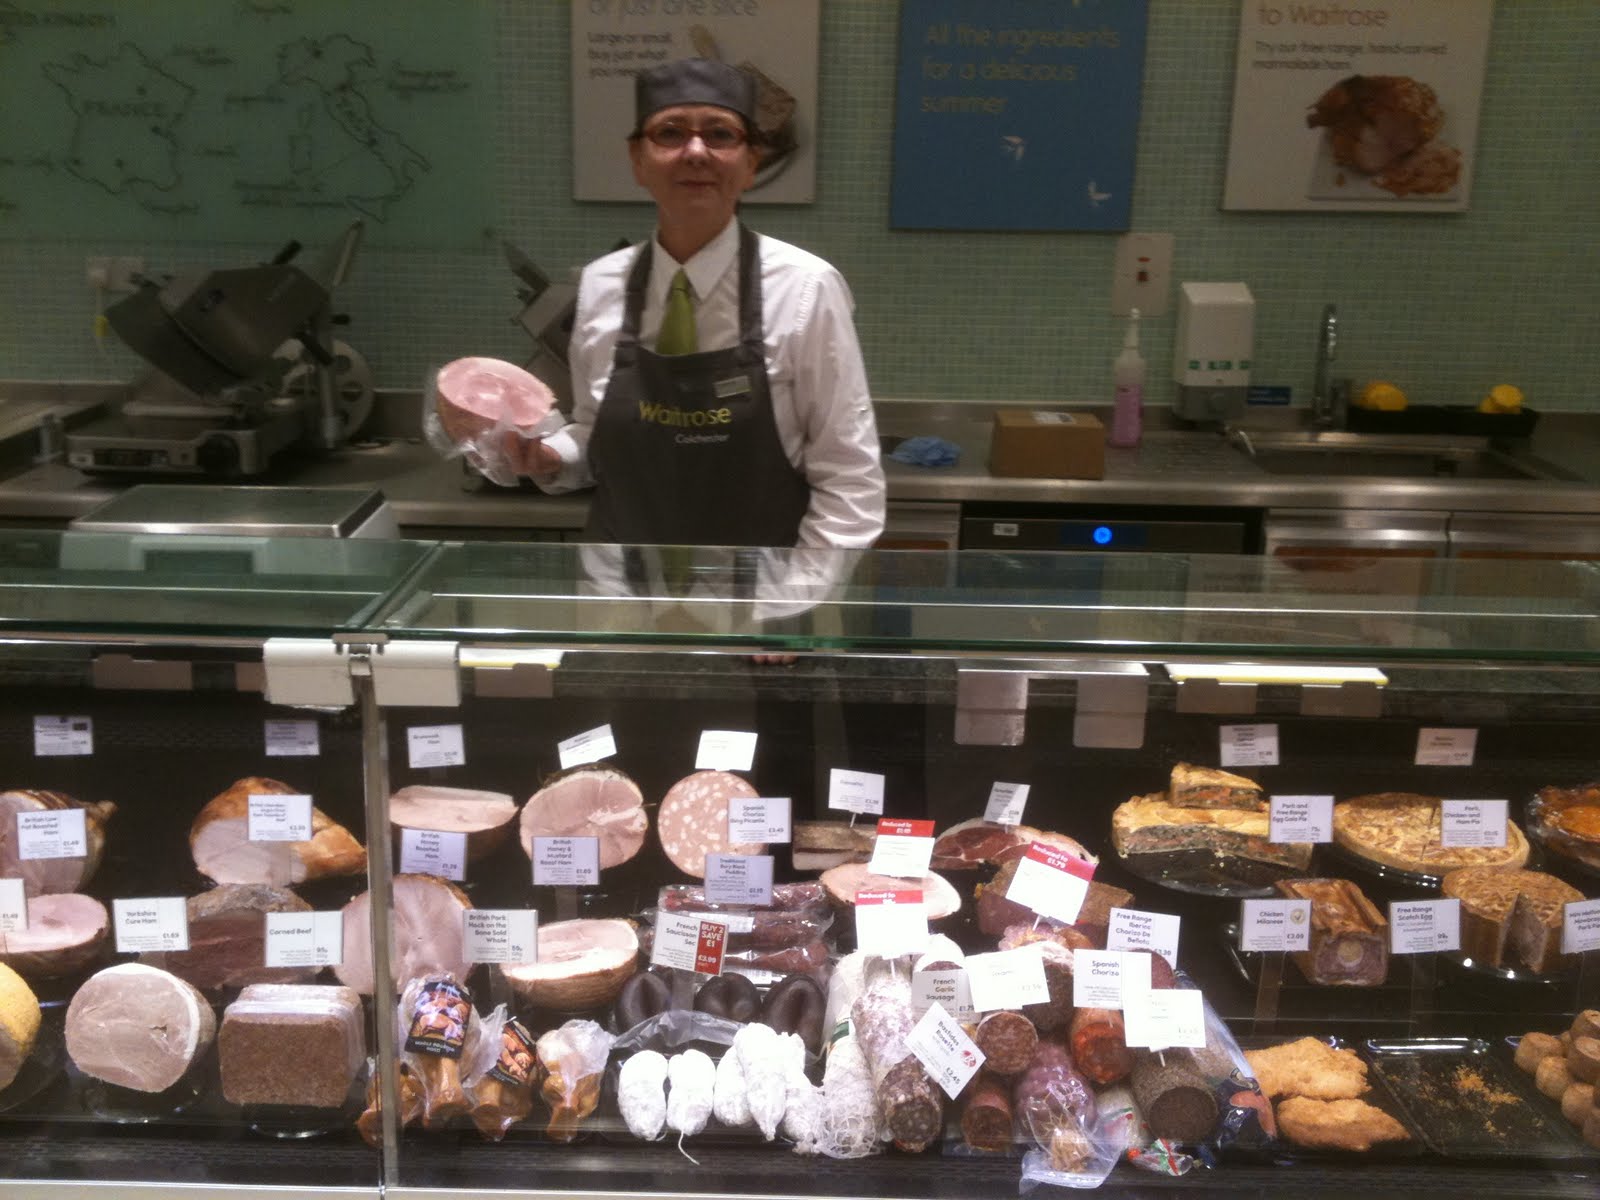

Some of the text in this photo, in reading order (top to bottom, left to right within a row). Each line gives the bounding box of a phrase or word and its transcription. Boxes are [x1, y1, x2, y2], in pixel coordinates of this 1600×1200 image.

[1258, 4, 1389, 27] to Waitrose
[958, 22, 992, 47] the
[999, 23, 1120, 55] ingredients
[920, 55, 1078, 81] for a delicious
[919, 95, 1009, 114] summer
[638, 400, 733, 428] Waitrose
[1032, 844, 1061, 859] Reduced
[126, 910, 157, 918] Yorkshire
[1411, 906, 1433, 914] Range
[1116, 912, 1152, 923] Free Range
[1398, 913, 1433, 922] Scotch Egg
[468, 921, 485, 929] Hock
[495, 921, 507, 929] the
[676, 921, 698, 932] French
[700, 923, 717, 933] BUY
[666, 927, 698, 939] Saucisson
[701, 930, 723, 942] SAVE
[1115, 927, 1151, 938] Chorizo De
[685, 938, 697, 946] Sec
[706, 939, 716, 949] £1
[1092, 960, 1120, 970] Spanish
[1092, 968, 1120, 977] Chorizo
[926, 994, 956, 1002] Sausage
[935, 1029, 955, 1052] Rosette
